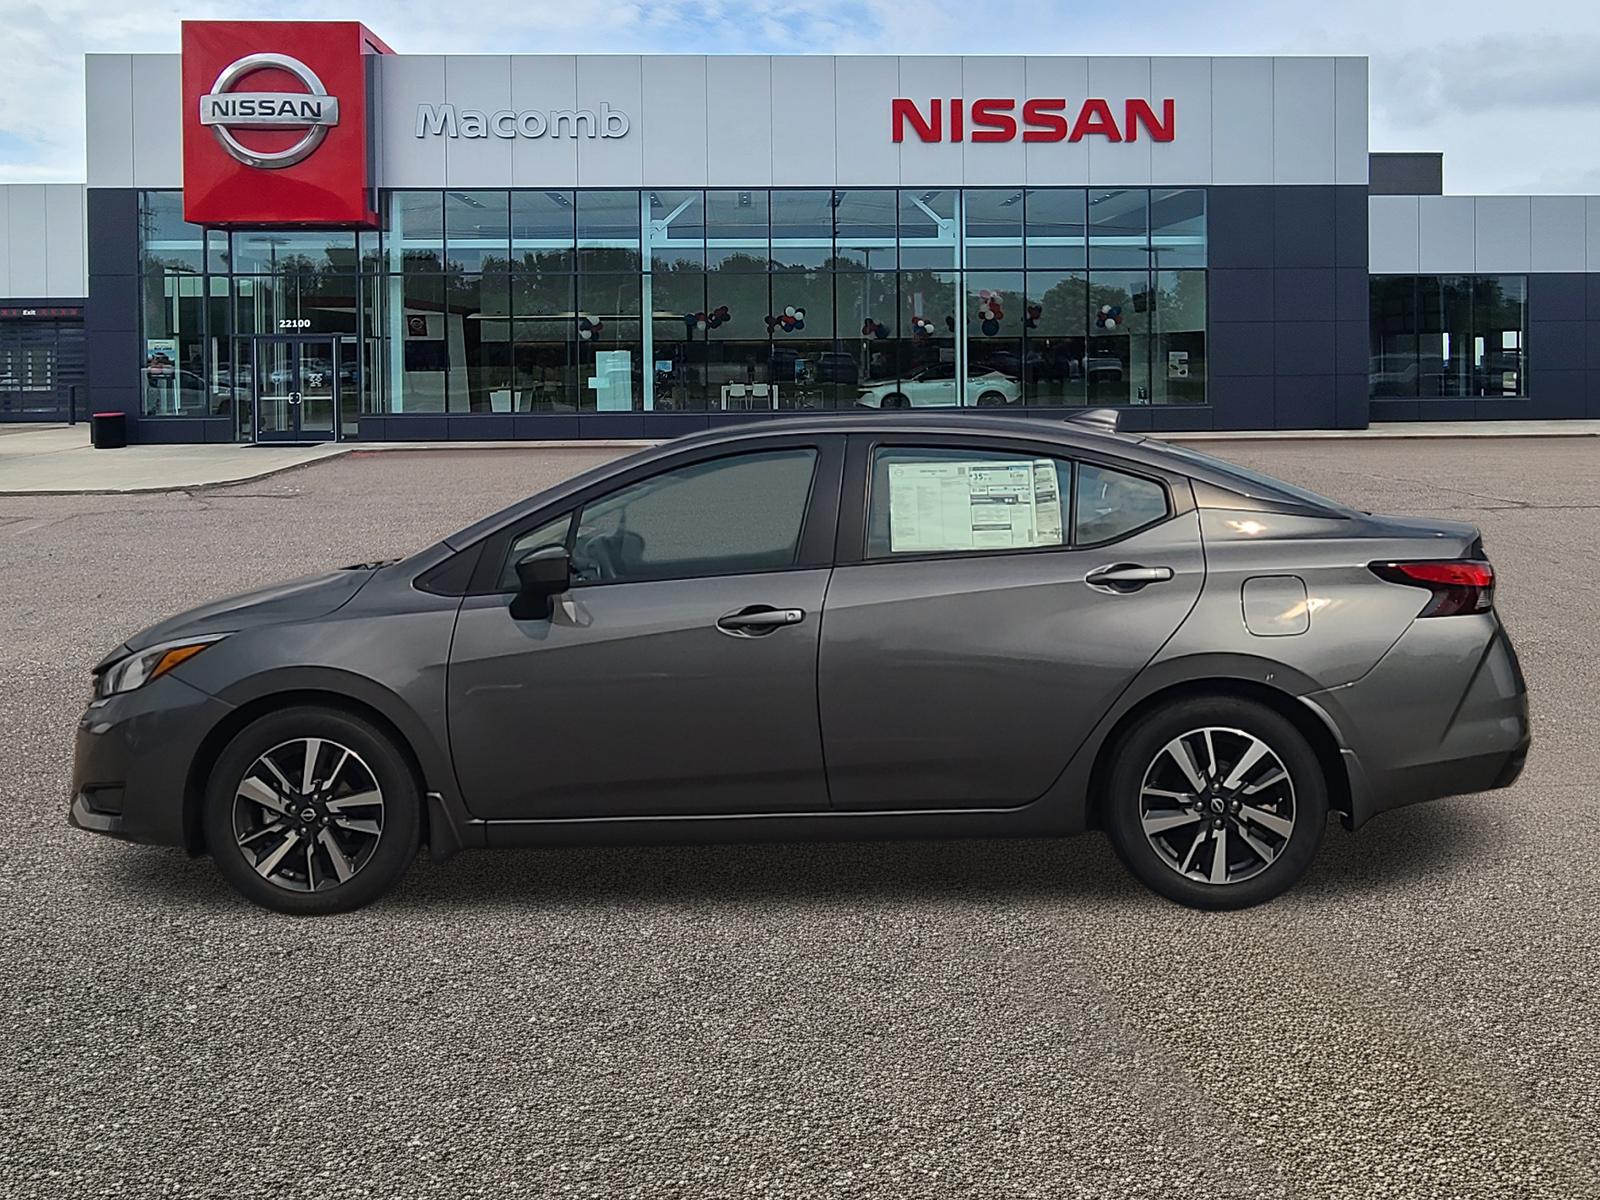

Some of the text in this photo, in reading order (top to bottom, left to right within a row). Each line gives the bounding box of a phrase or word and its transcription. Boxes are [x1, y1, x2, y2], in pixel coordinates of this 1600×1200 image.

[212, 100, 322, 118] NISSAN
[415, 102, 630, 139] Macomb
[892, 98, 1175, 143] NISSAN
[279, 319, 311, 328] 22100
